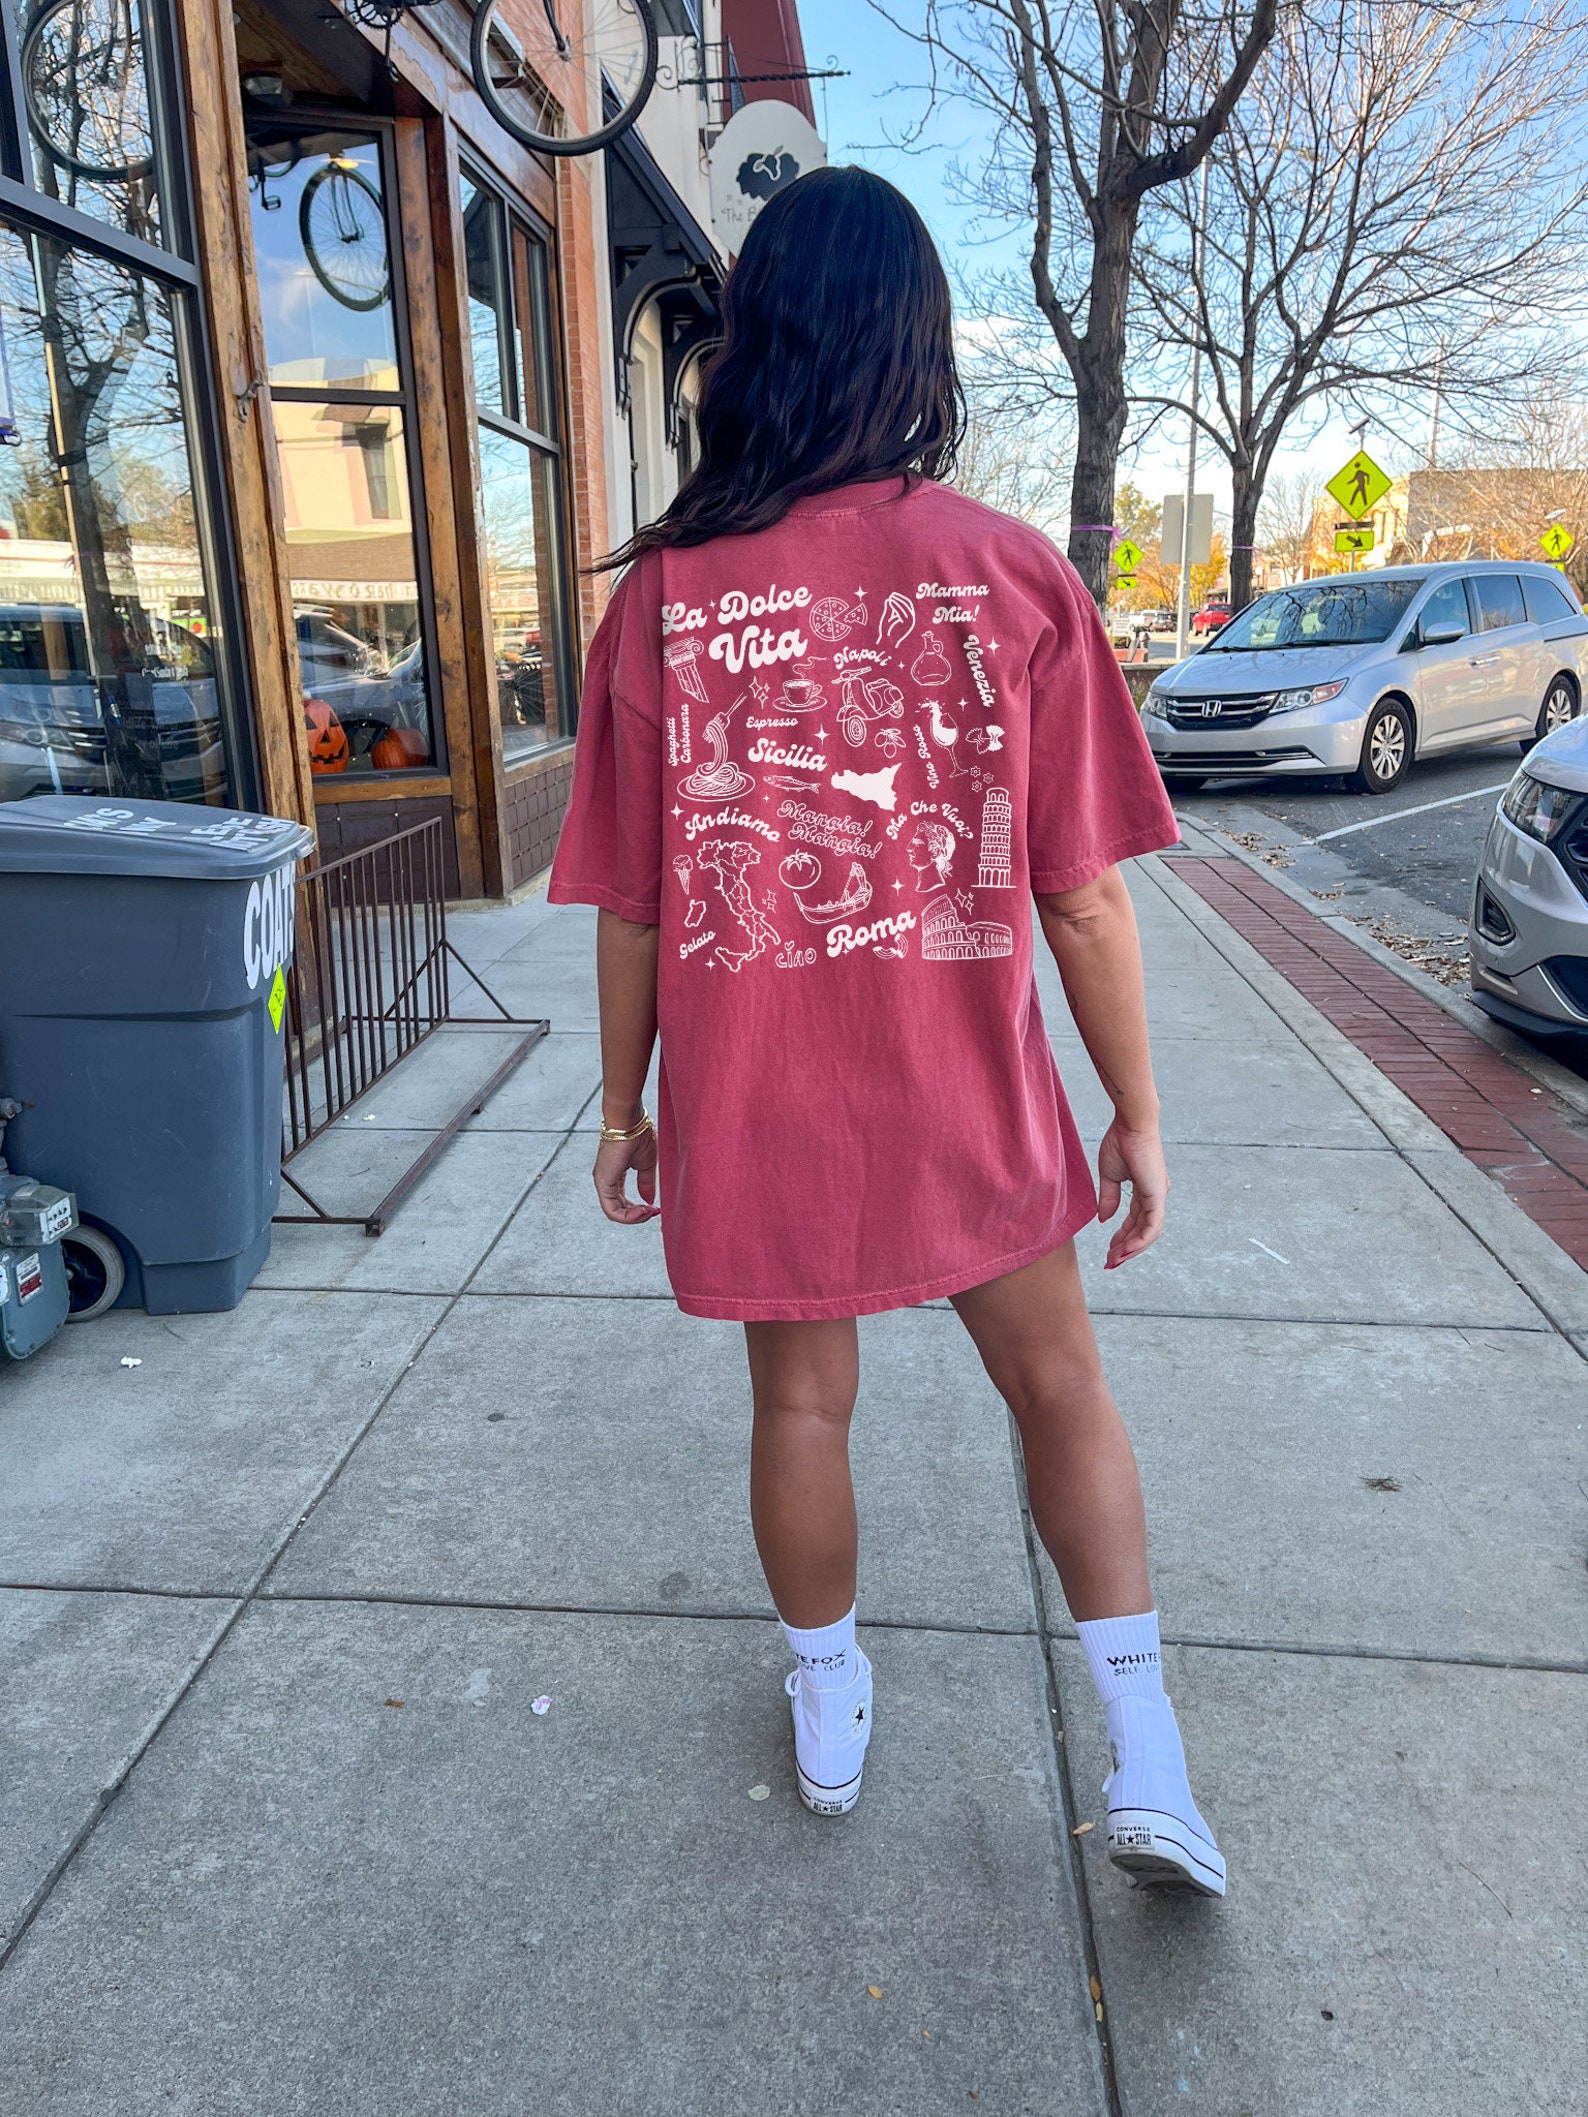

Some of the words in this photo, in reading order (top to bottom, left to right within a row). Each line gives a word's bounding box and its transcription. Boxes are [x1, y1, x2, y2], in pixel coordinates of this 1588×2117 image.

[915, 582, 990, 600] Mamma
[661, 602, 708, 636] La
[717, 584, 813, 625] Dolce
[932, 604, 980, 625] Mia!
[708, 625, 808, 674] Vita
[833, 646, 892, 670] Napoli
[963, 634, 996, 708] Venezia
[680, 703, 692, 764] Carbonara
[745, 716, 799, 731] Espresso
[747, 738, 828, 772] Sicilia
[685, 806, 781, 842] Andiamo
[776, 799, 874, 838] Mangia!
[885, 813, 908, 841] Ma
[910, 800, 938, 815] Che
[787, 821, 883, 859] Mangia!
[679, 930, 716, 960] Gelato
[826, 910, 917, 958] Roma
[1135, 1833, 1152, 1845] STAR
